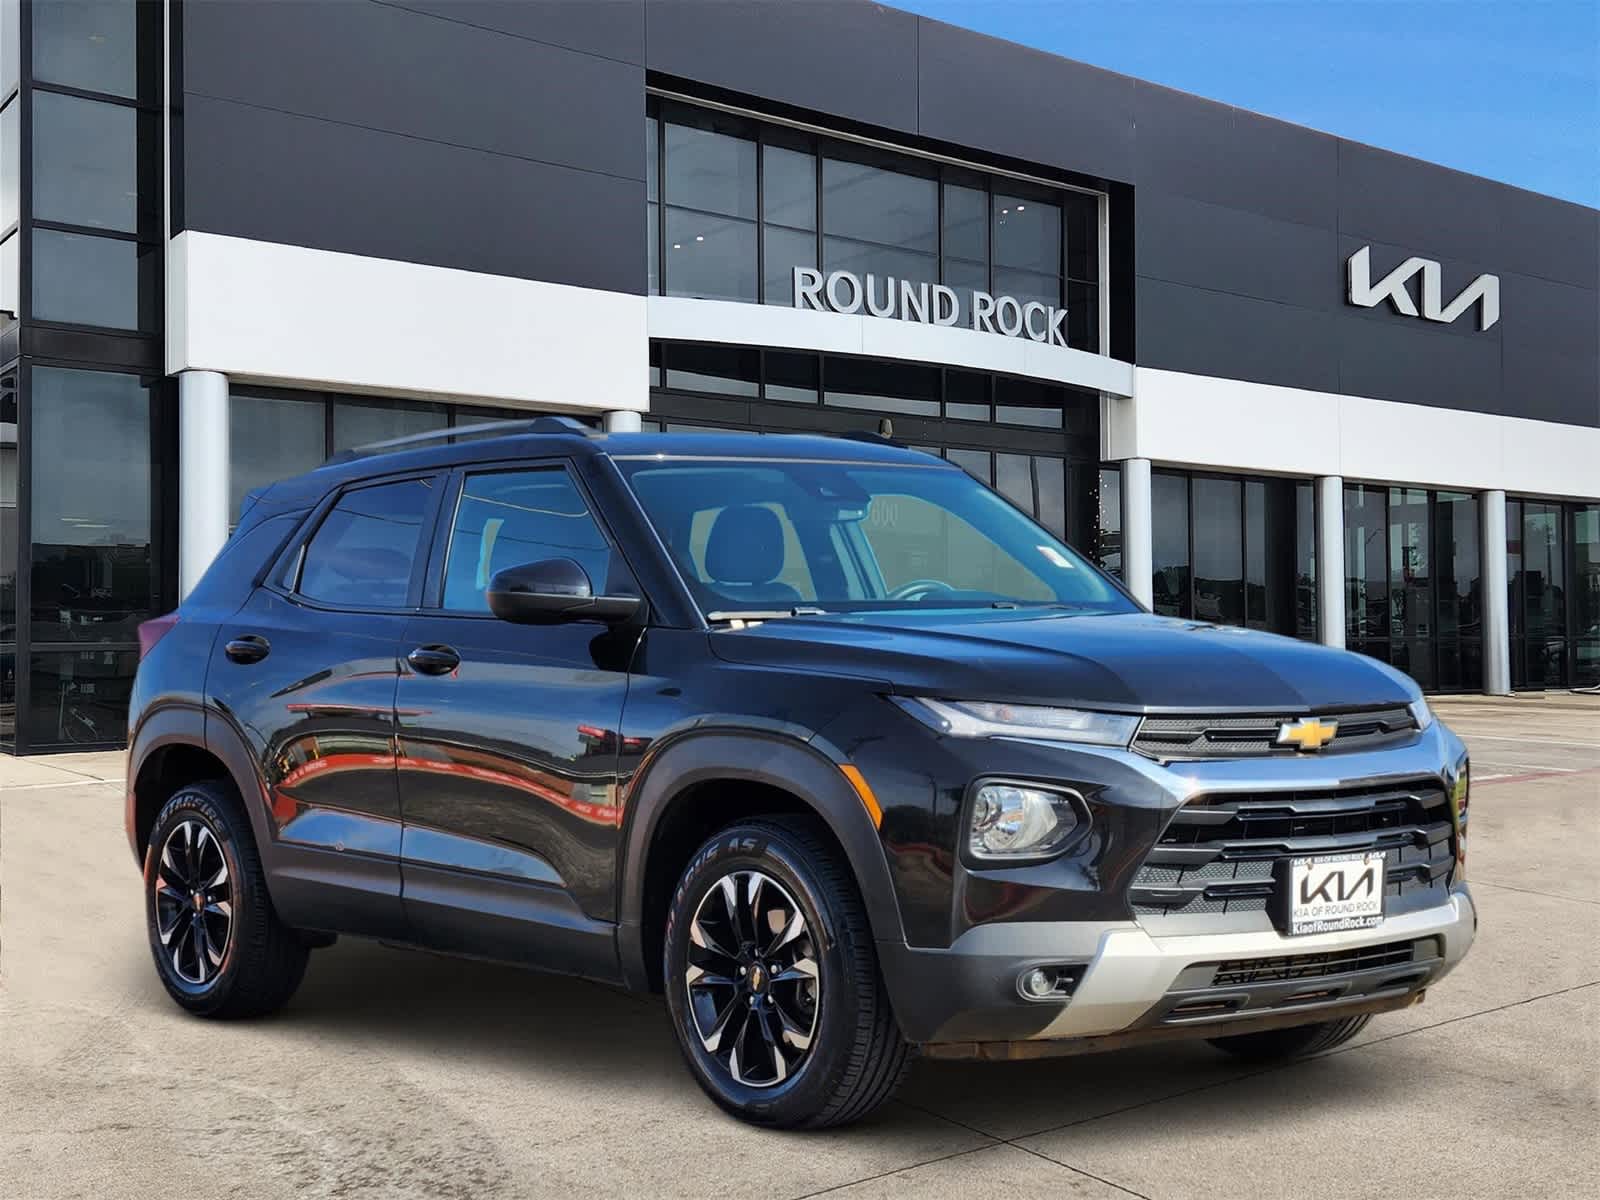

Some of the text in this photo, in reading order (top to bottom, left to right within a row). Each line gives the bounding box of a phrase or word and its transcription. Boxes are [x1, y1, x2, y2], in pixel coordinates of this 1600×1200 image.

[792, 265, 1069, 348] ROUND ROCK
[1347, 245, 1500, 331] KIA
[1294, 901, 1379, 917] KIA OF ROUND ROCK
[1300, 868, 1374, 905] KIA
